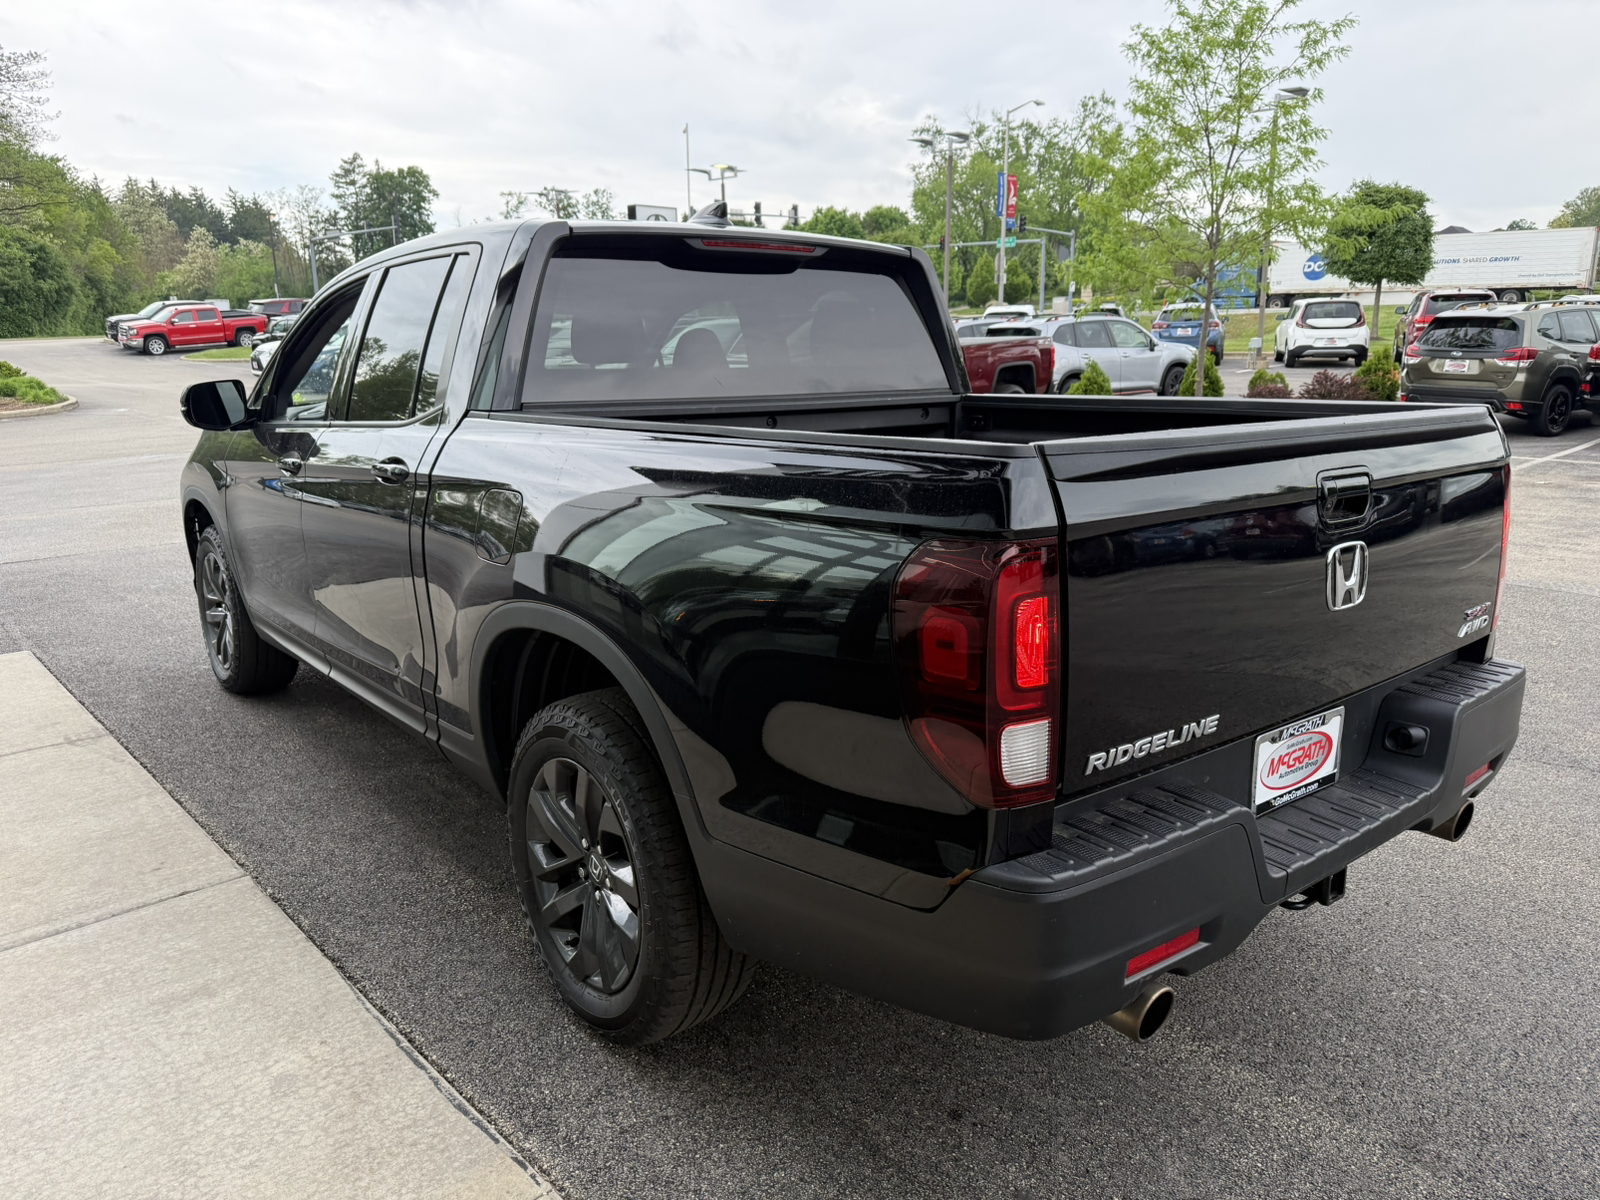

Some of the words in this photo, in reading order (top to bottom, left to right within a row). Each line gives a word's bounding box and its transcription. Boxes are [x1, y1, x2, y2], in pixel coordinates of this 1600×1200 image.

[1462, 256, 1487, 264] SHARED
[1488, 255, 1520, 263] GROWTH
[1084, 714, 1220, 776] RIDGELINE
[1279, 764, 1305, 780] Automotive
[1304, 759, 1319, 770] Group
[1275, 782, 1319, 806] GoMcGrath.com
